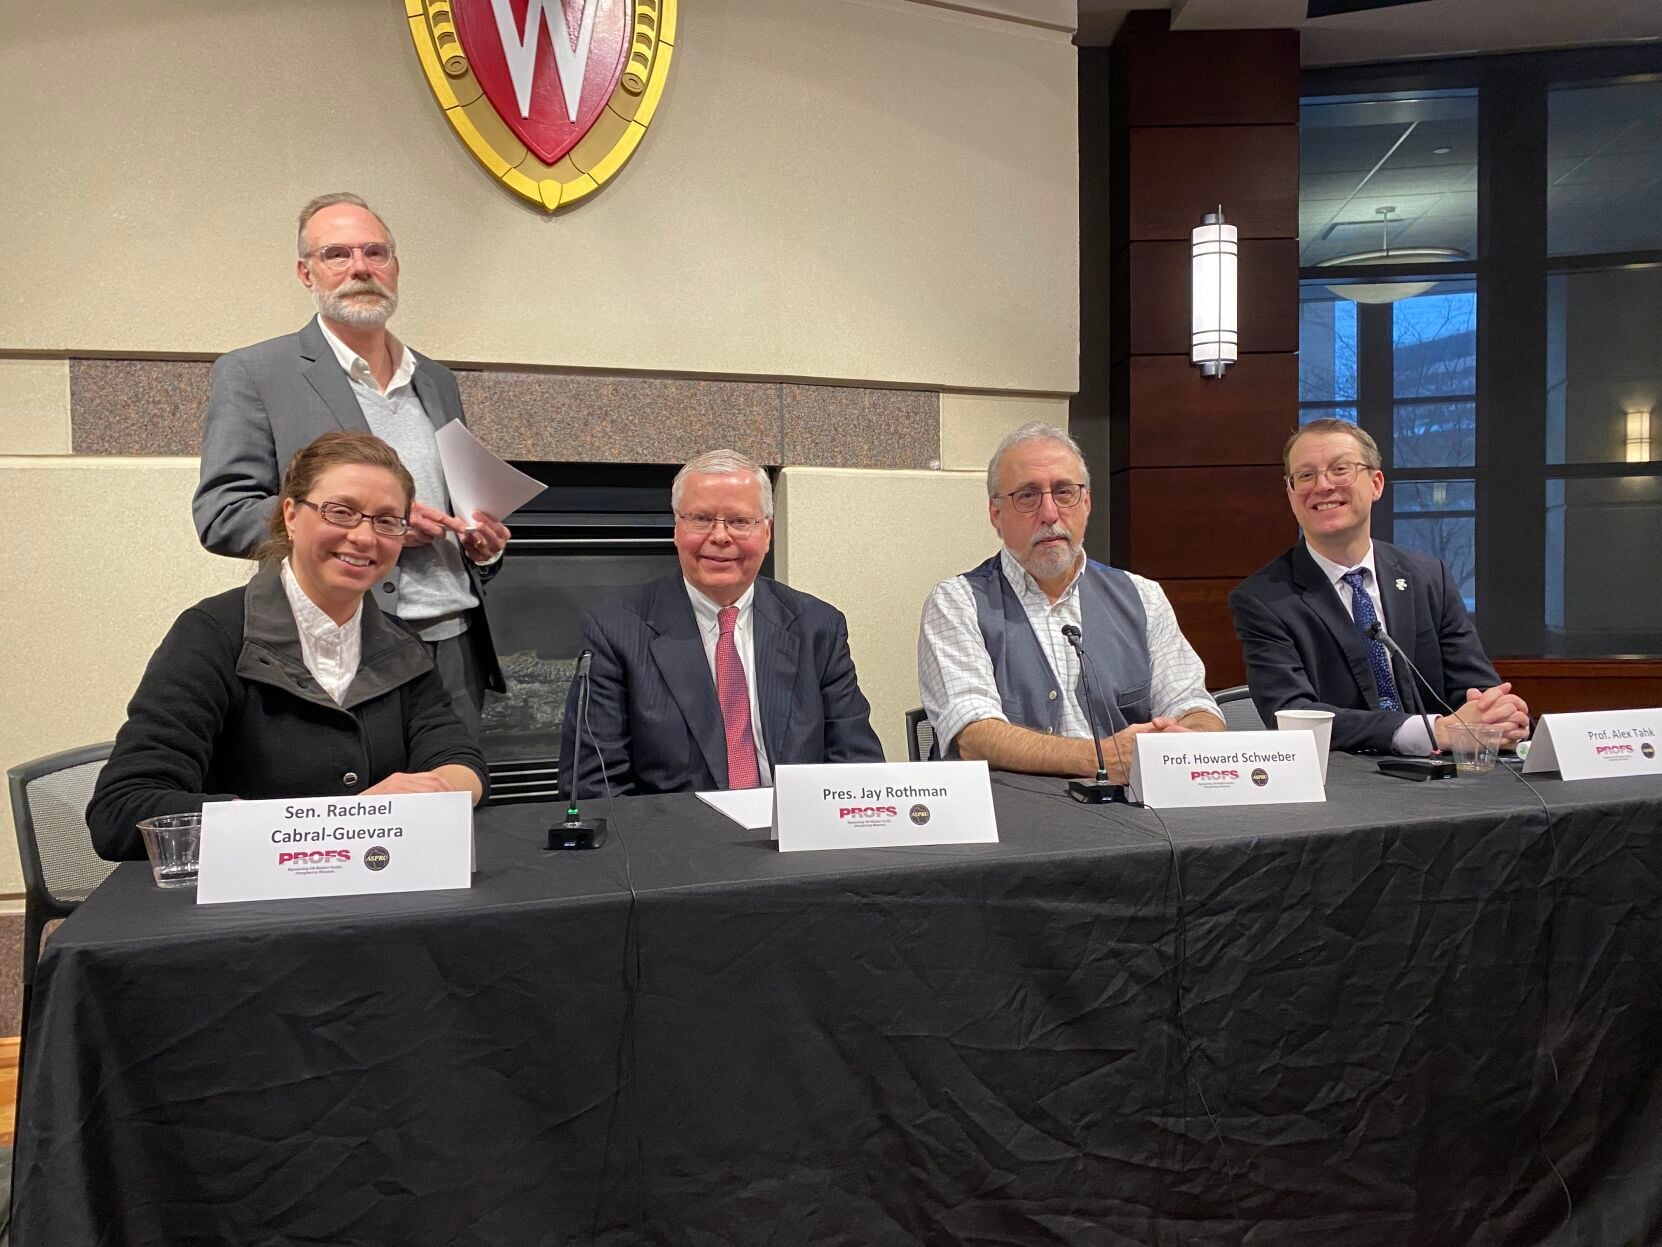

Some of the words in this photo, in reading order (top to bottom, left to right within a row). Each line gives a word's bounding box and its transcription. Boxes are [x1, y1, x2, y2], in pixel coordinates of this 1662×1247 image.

[490, 0, 599, 124] W
[1588, 730, 1611, 740] Prof.
[1612, 729, 1632, 739] Alex
[1632, 728, 1655, 737] Tahk
[1596, 745, 1634, 754] PROFS
[1163, 754, 1191, 765] Prof.
[1194, 753, 1239, 764] Howard
[1242, 752, 1296, 763] Schweber
[1191, 770, 1240, 780] PROFS
[823, 789, 856, 800] Pres.
[861, 787, 881, 800] Jay
[886, 786, 948, 798] Rothman
[285, 806, 320, 819] Sen.
[327, 801, 392, 817] Rachael
[839, 806, 898, 818] PROFS
[271, 826, 403, 843] Cabral-Guevara
[279, 849, 351, 865] PROFS
